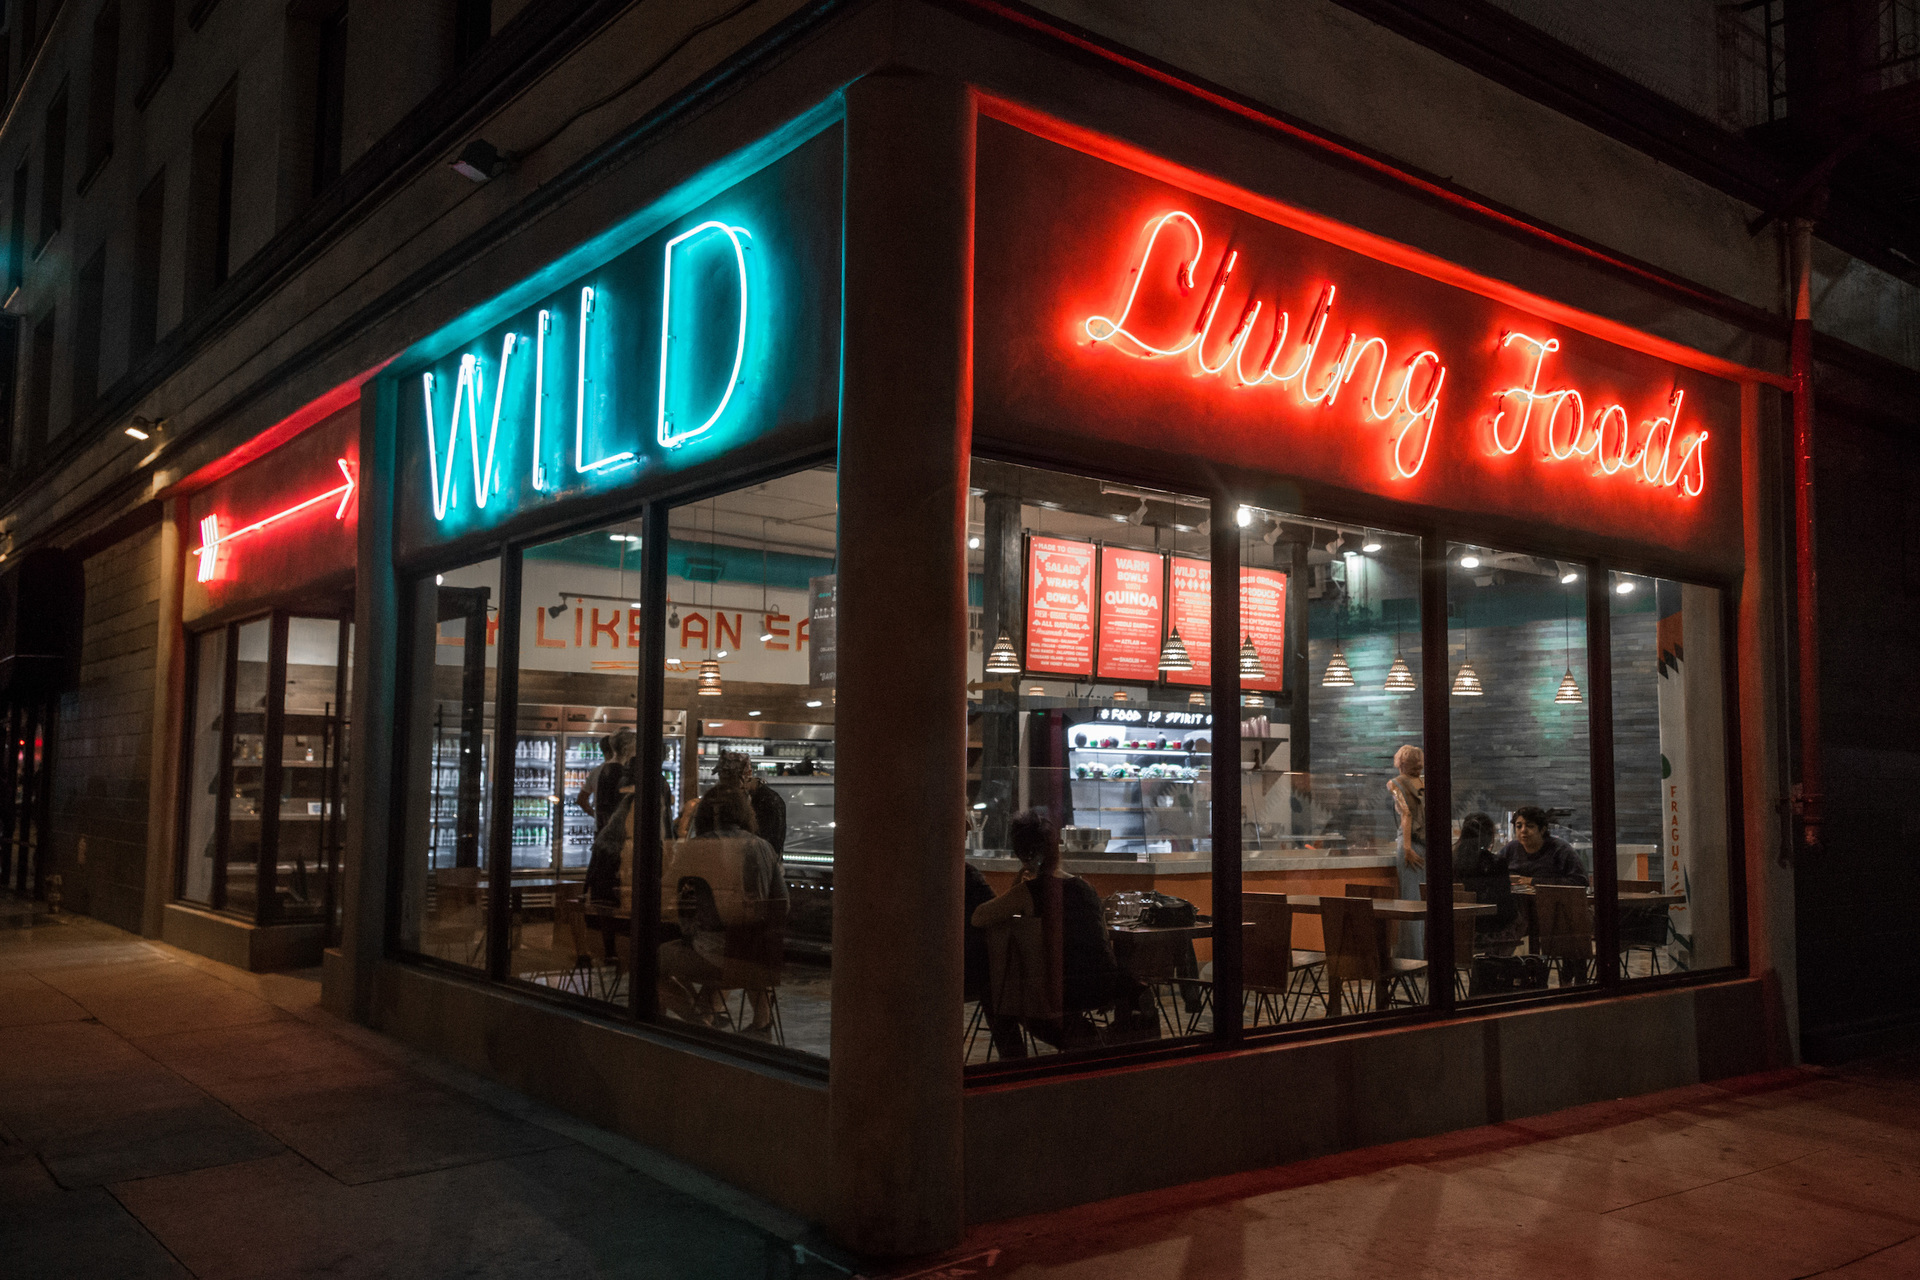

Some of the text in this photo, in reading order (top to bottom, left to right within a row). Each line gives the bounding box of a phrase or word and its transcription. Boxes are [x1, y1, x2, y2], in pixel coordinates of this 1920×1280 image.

[1084, 210, 1710, 496] Living Foods
[423, 220, 749, 520] WILD
[1038, 543, 1056, 551] MADE
[1045, 561, 1081, 575] SALADS
[1115, 557, 1150, 572] WARM
[1117, 571, 1148, 584] BOWLS
[1174, 566, 1197, 578] WILD
[1046, 576, 1079, 590] WRAPS
[1125, 582, 1141, 590] WITH
[1046, 591, 1079, 605] BOWLS
[1104, 590, 1158, 610] QUINOA
[680, 611, 742, 650] AN
[1041, 620, 1053, 628] ALL
[1111, 708, 1204, 725] FOOD IS SPIRIT
